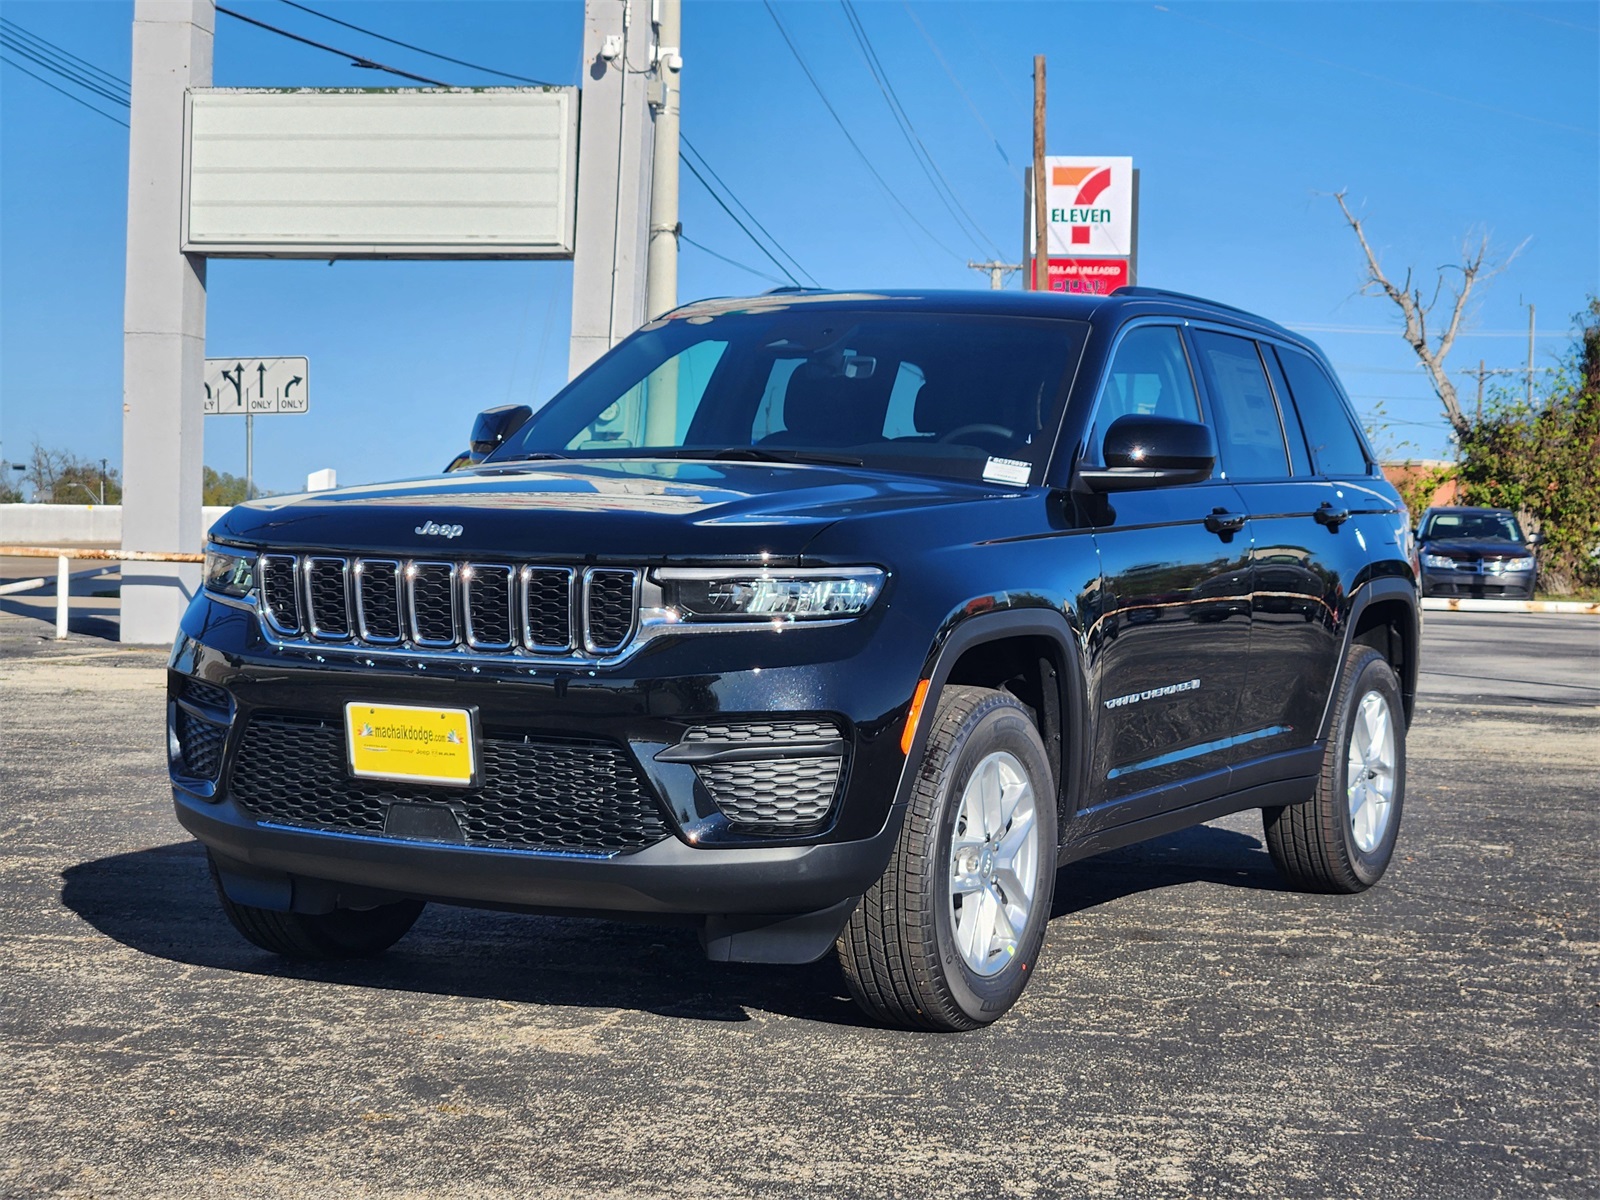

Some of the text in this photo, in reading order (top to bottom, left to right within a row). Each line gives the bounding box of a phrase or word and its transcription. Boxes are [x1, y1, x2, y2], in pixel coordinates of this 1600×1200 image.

[1052, 166, 1111, 244] 7
[1047, 265, 1121, 275] GULAR UNLEADED
[204, 401, 215, 410] LY
[251, 400, 272, 410] ONLY
[281, 400, 304, 409] ONLY
[414, 520, 464, 539] Jeep
[1104, 681, 1192, 709] GRAND CHEROKEE
[374, 724, 446, 744] machaikdodge.com
